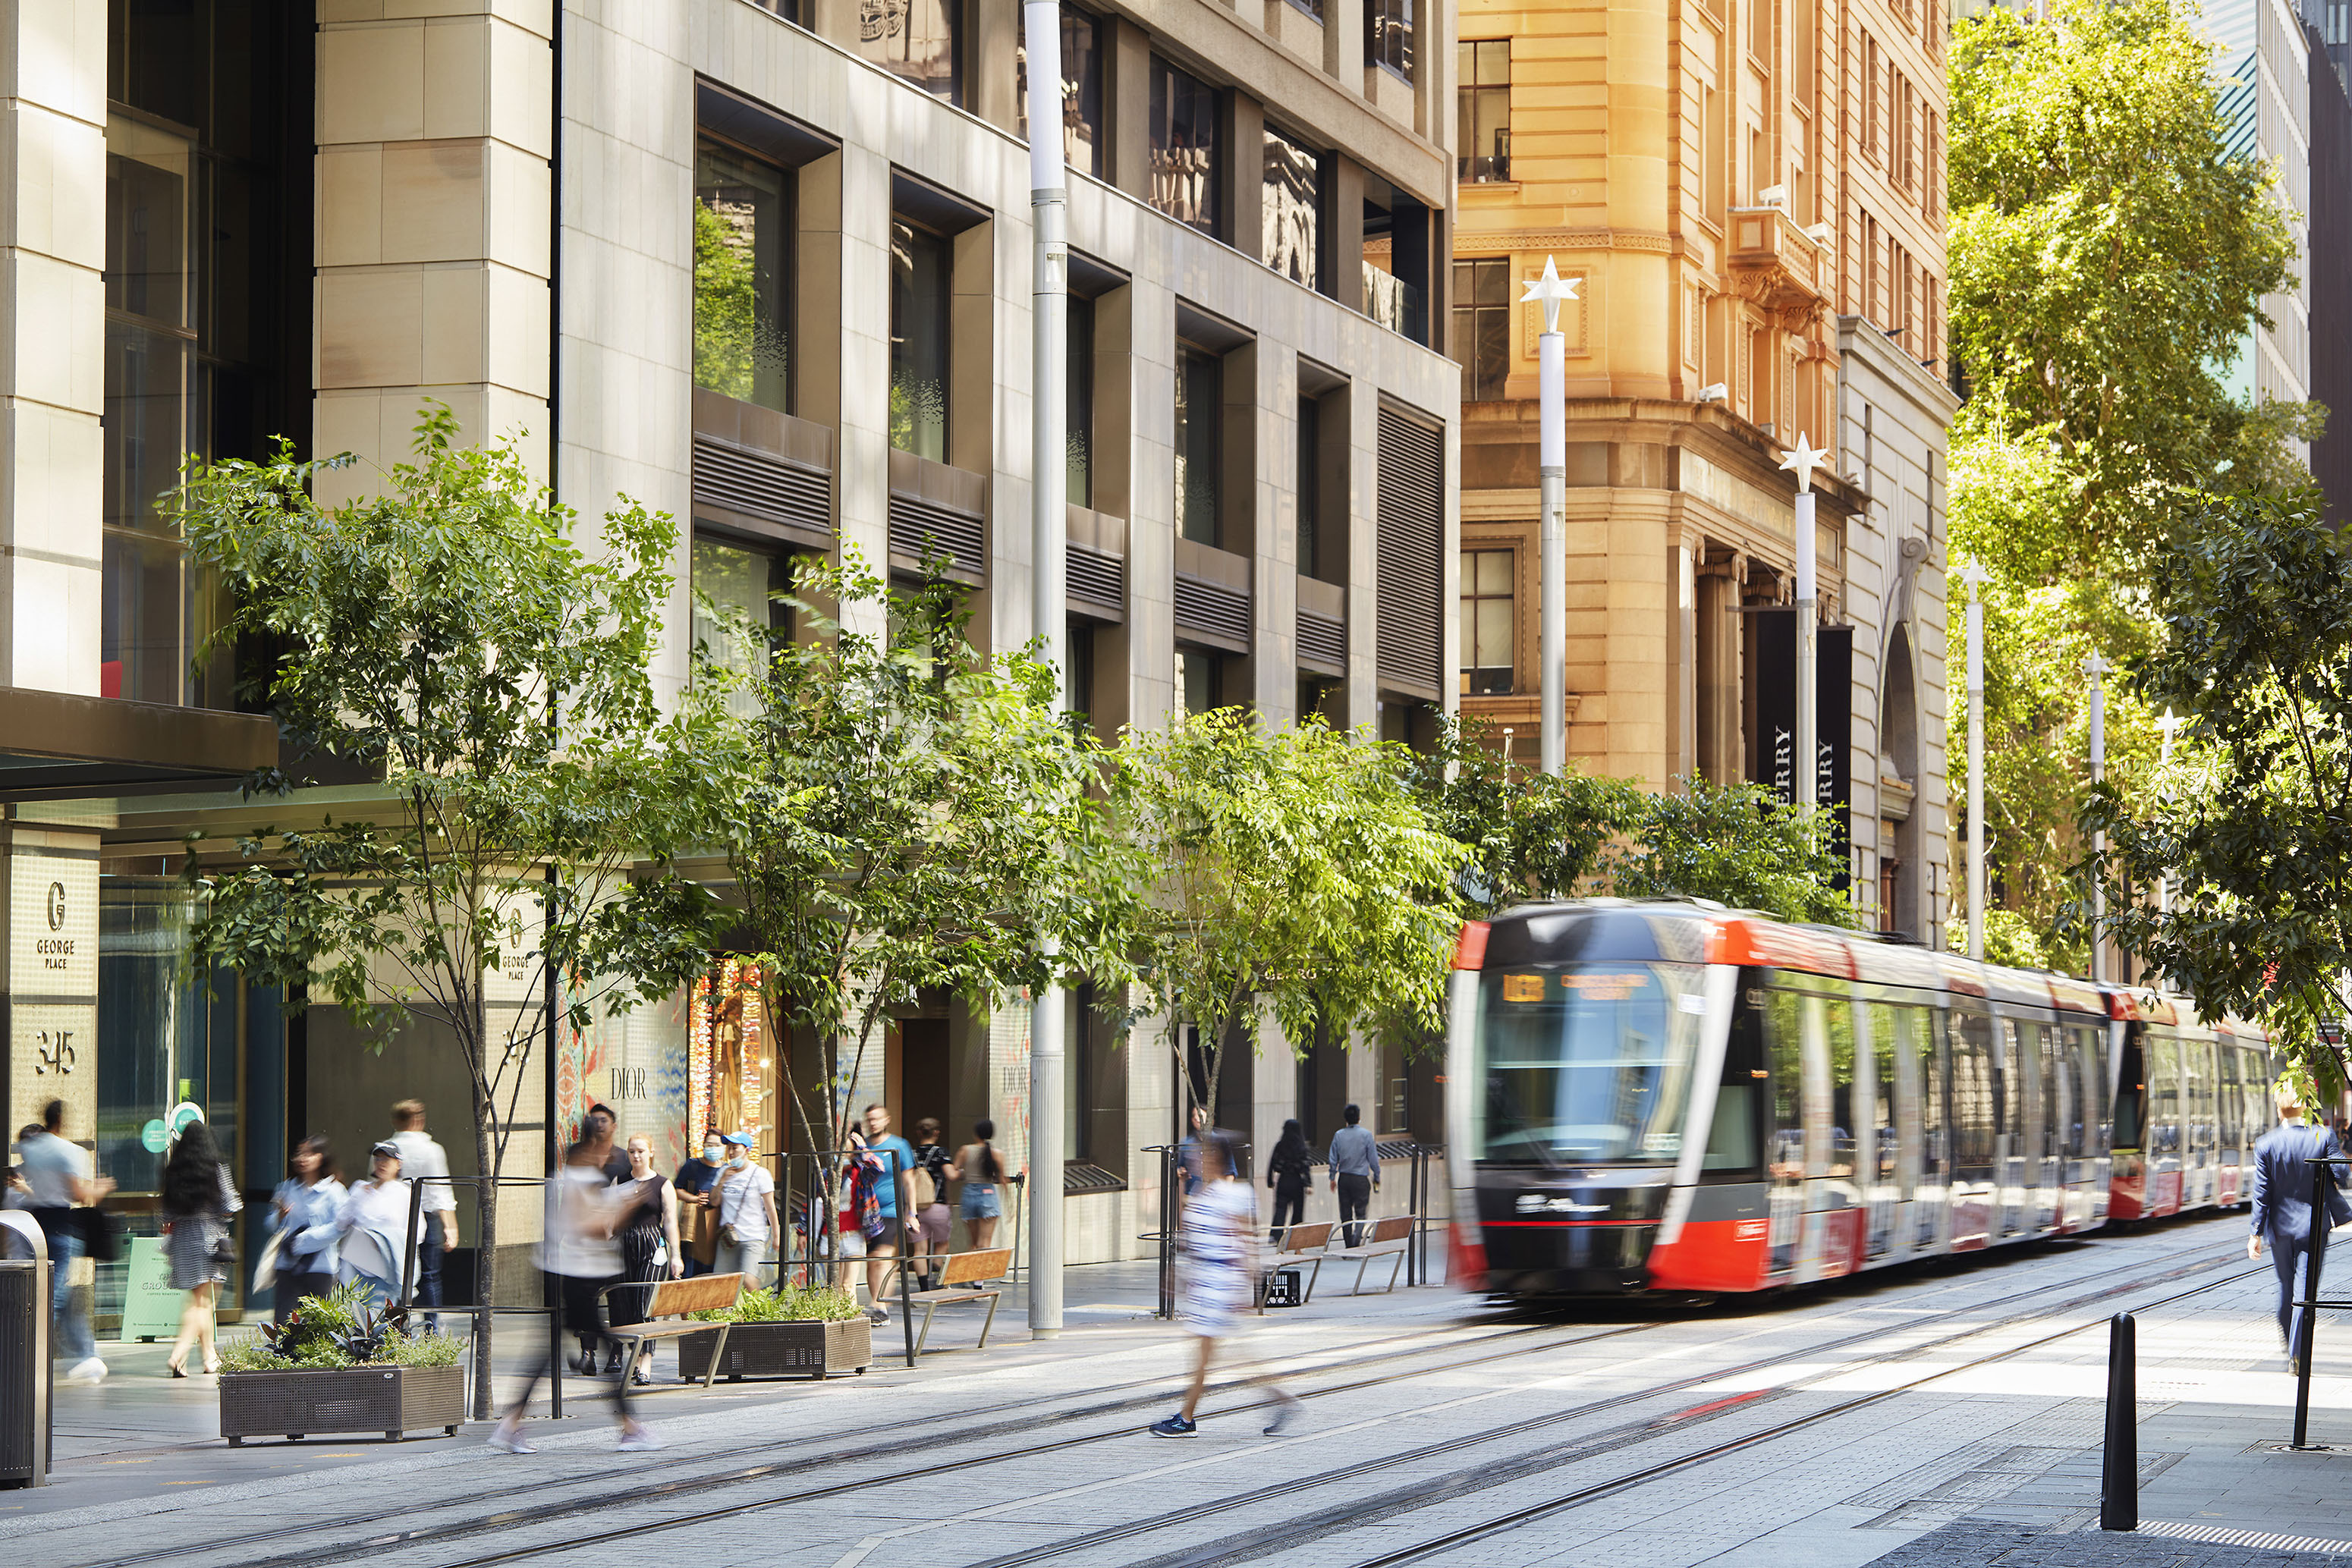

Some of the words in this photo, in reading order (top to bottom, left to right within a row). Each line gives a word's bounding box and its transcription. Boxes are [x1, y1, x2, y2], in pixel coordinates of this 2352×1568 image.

[36, 939, 74, 954] GEORGE
[45, 958, 67, 969] PLACE
[502, 956, 529, 968] GEORGE
[508, 971, 524, 980] PLACE
[35, 1030, 75, 1074] 345
[611, 1067, 646, 1100] DIOR
[1003, 1066, 1027, 1093] DIOR
